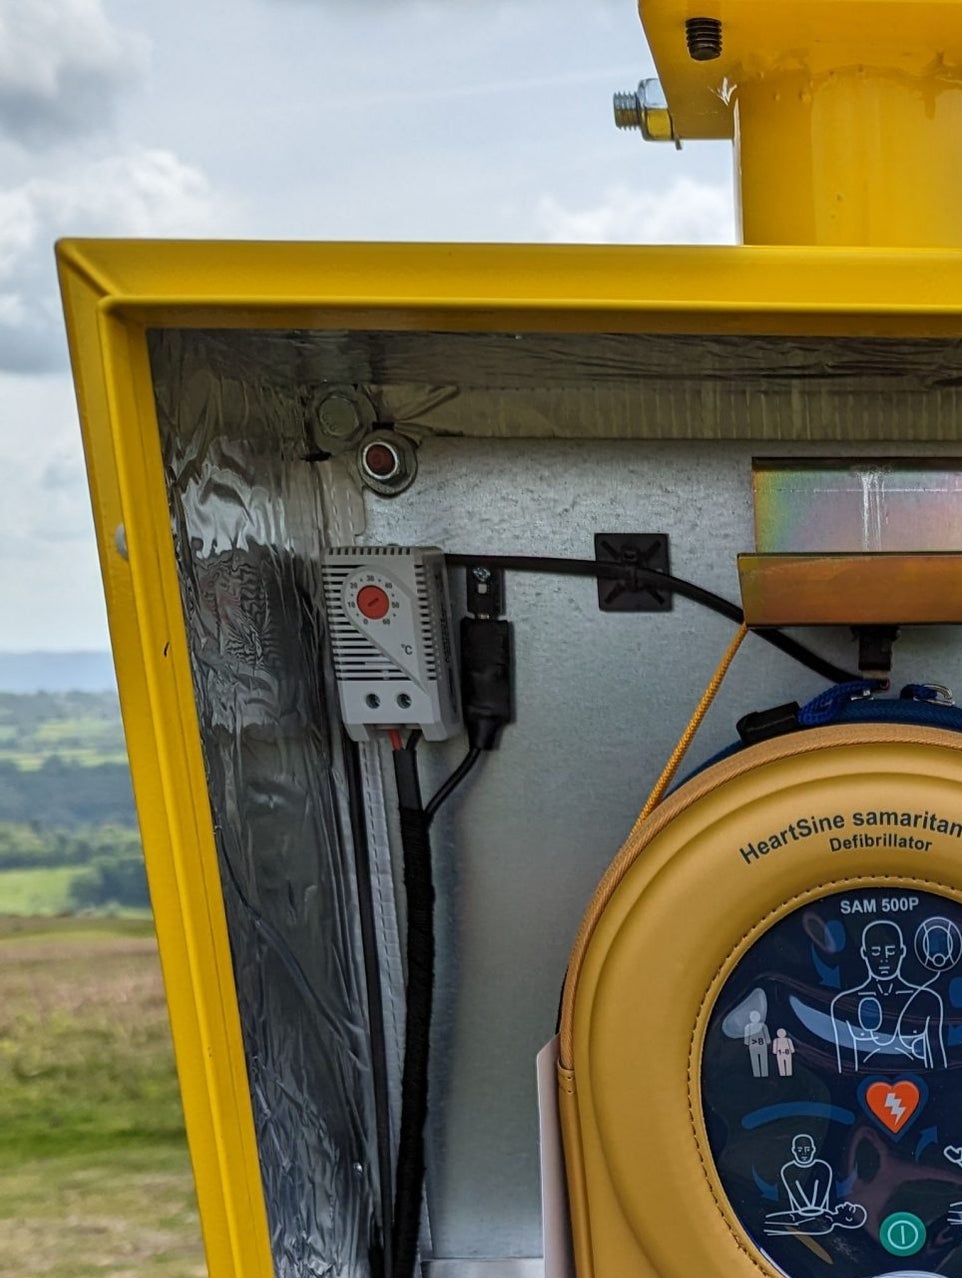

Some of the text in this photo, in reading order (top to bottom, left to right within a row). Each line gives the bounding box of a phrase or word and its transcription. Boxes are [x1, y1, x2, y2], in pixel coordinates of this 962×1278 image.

[739, 812, 846, 864] HeartSine
[829, 833, 933, 853] Defibrillator
[840, 897, 920, 915] SAM 500P
